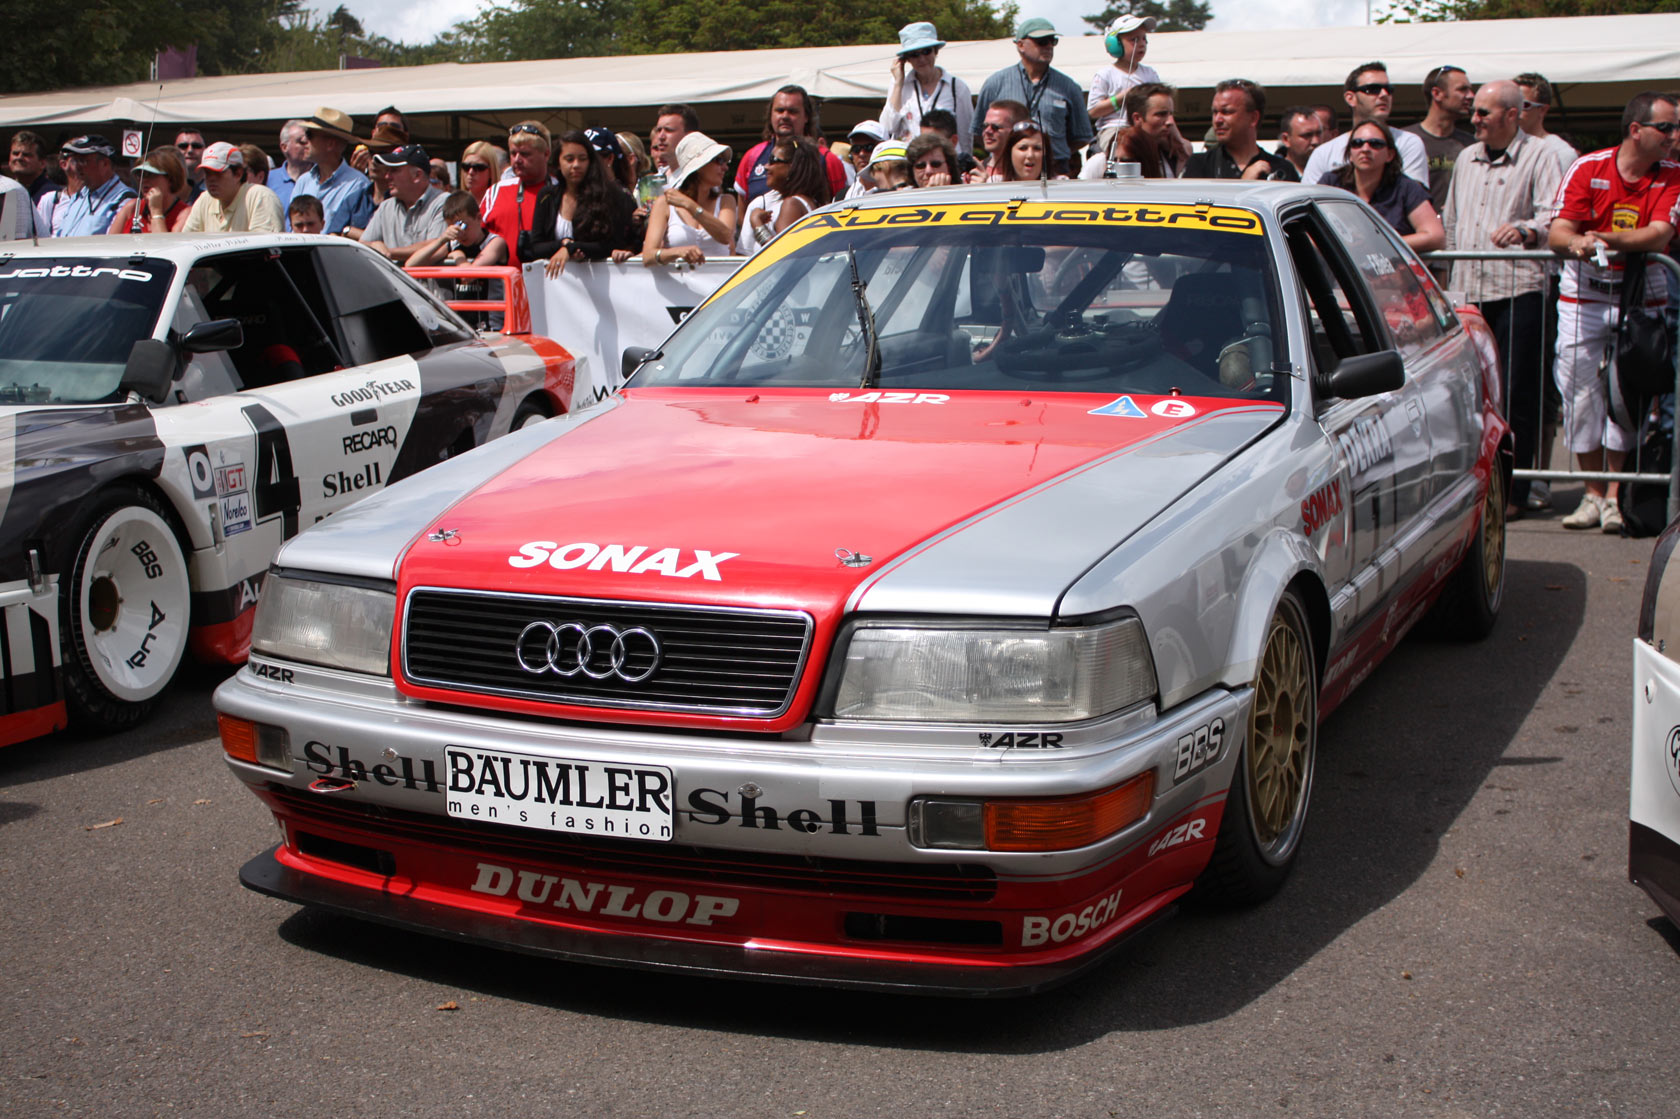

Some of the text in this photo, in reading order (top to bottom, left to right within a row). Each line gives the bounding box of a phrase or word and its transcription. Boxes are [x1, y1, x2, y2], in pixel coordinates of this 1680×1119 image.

[790, 207, 1256, 234] Audi quattro
[331, 379, 416, 407] GOODYEAR
[846, 391, 950, 405] AZR
[1163, 402, 1185, 416] E
[343, 426, 397, 454] RECARO
[1338, 414, 1392, 477] DEKRA
[241, 403, 301, 546] 4
[323, 462, 381, 498] Shell
[1301, 478, 1343, 537] SONAX
[130, 540, 163, 579] BBS
[508, 541, 741, 581] SONAX
[126, 600, 166, 669] Audi
[256, 665, 294, 684] AZR
[990, 732, 1065, 749] AZR
[1174, 717, 1224, 780] BBS
[304, 740, 442, 793] Shell
[447, 750, 670, 815] BÄUMLER
[448, 799, 671, 837] men's fashion
[688, 788, 881, 837] Shell
[1150, 819, 1206, 856] AZR
[470, 862, 740, 927] DUNLOP
[1022, 890, 1122, 947] BOSCH
